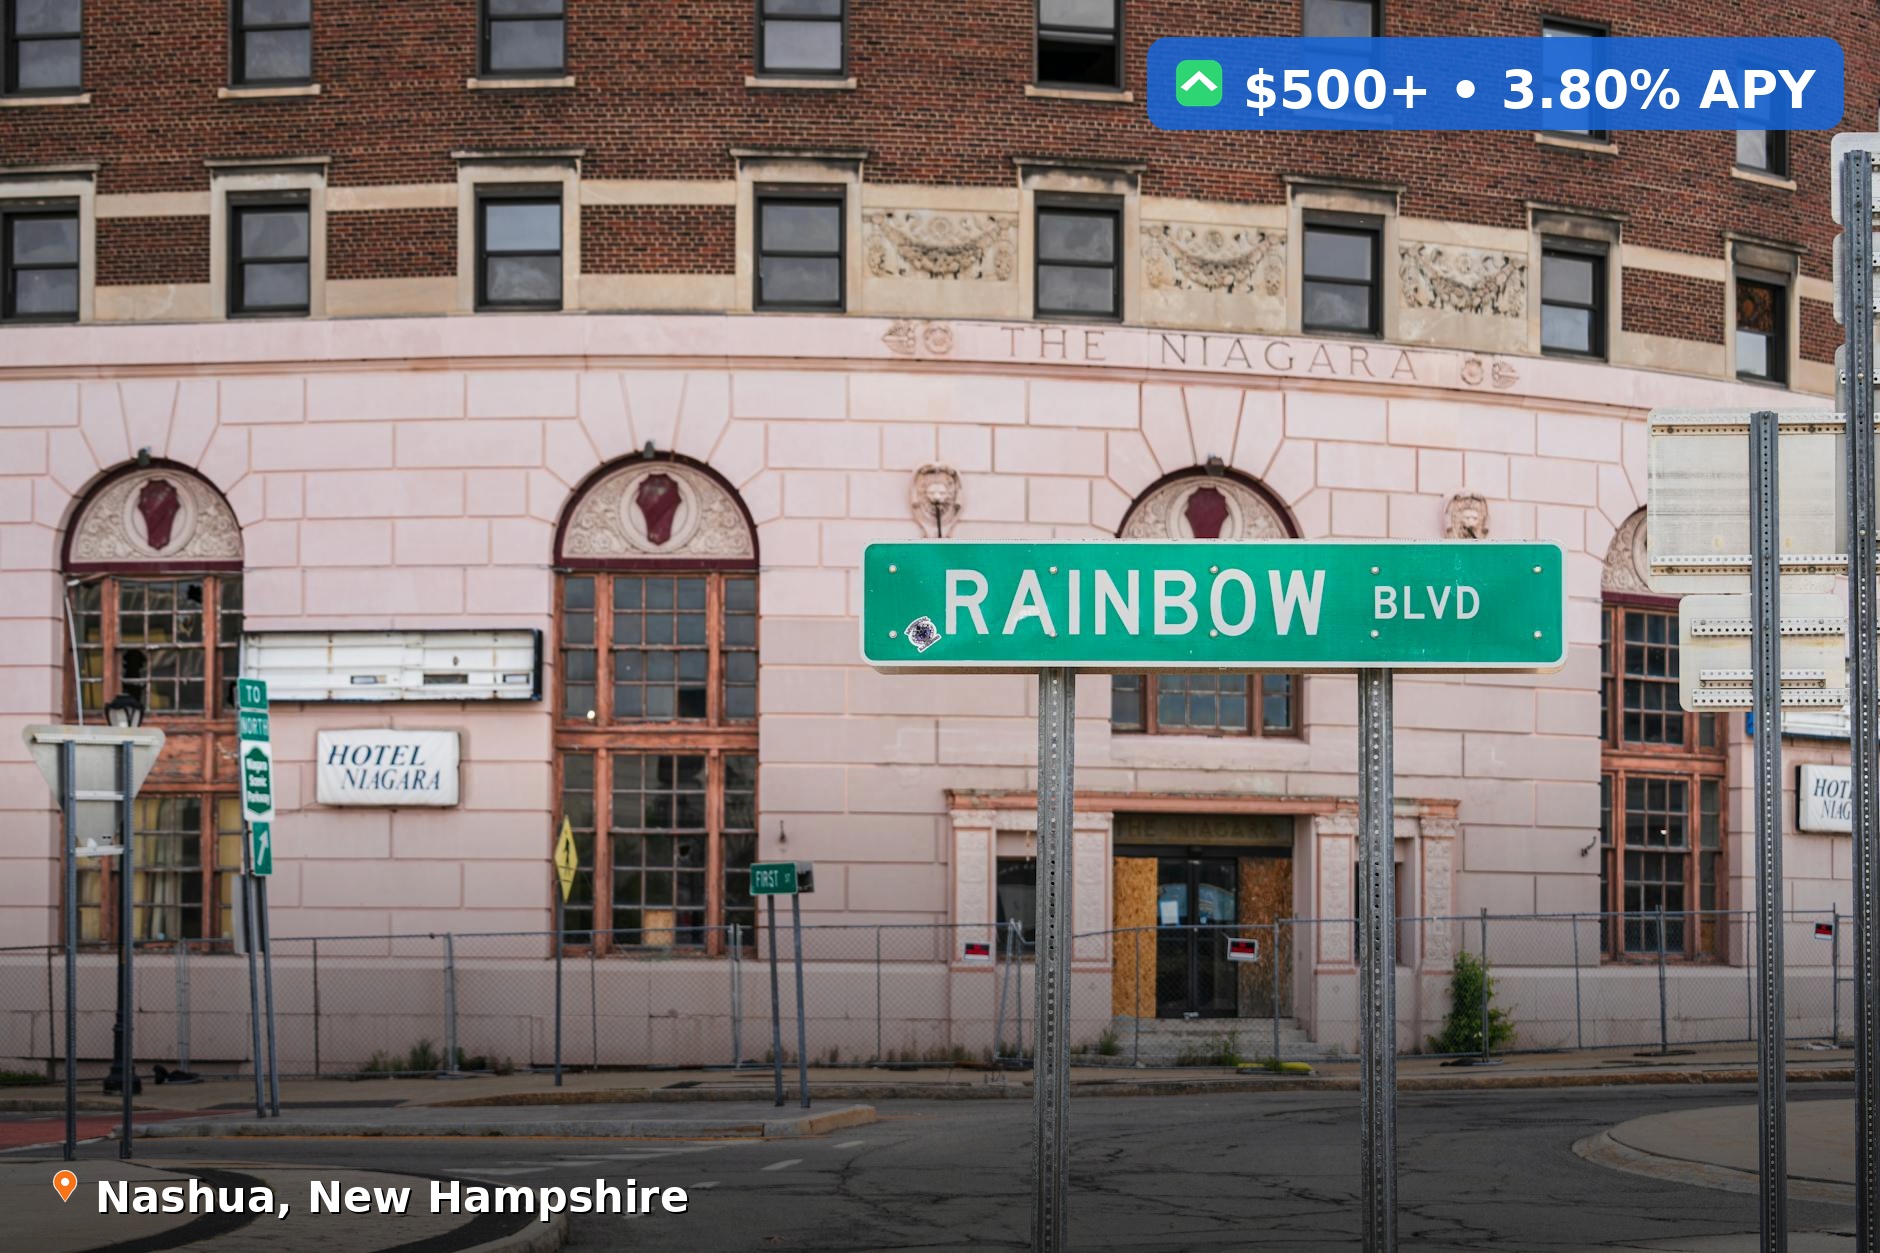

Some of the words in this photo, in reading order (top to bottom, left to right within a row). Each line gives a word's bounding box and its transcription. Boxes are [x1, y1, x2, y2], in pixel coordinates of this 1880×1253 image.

[1001, 327, 1106, 362] THE
[1161, 332, 1419, 381] NIAGARA
[944, 568, 1326, 637] RAINBOW
[1374, 584, 1481, 620] BLVD
[245, 684, 261, 703] TO
[326, 744, 426, 766] HOTEL
[341, 768, 441, 790] NIAGARA
[1813, 778, 1851, 799] HOT
[1820, 799, 1851, 821] NIAG
[755, 869, 779, 888] FIRST
